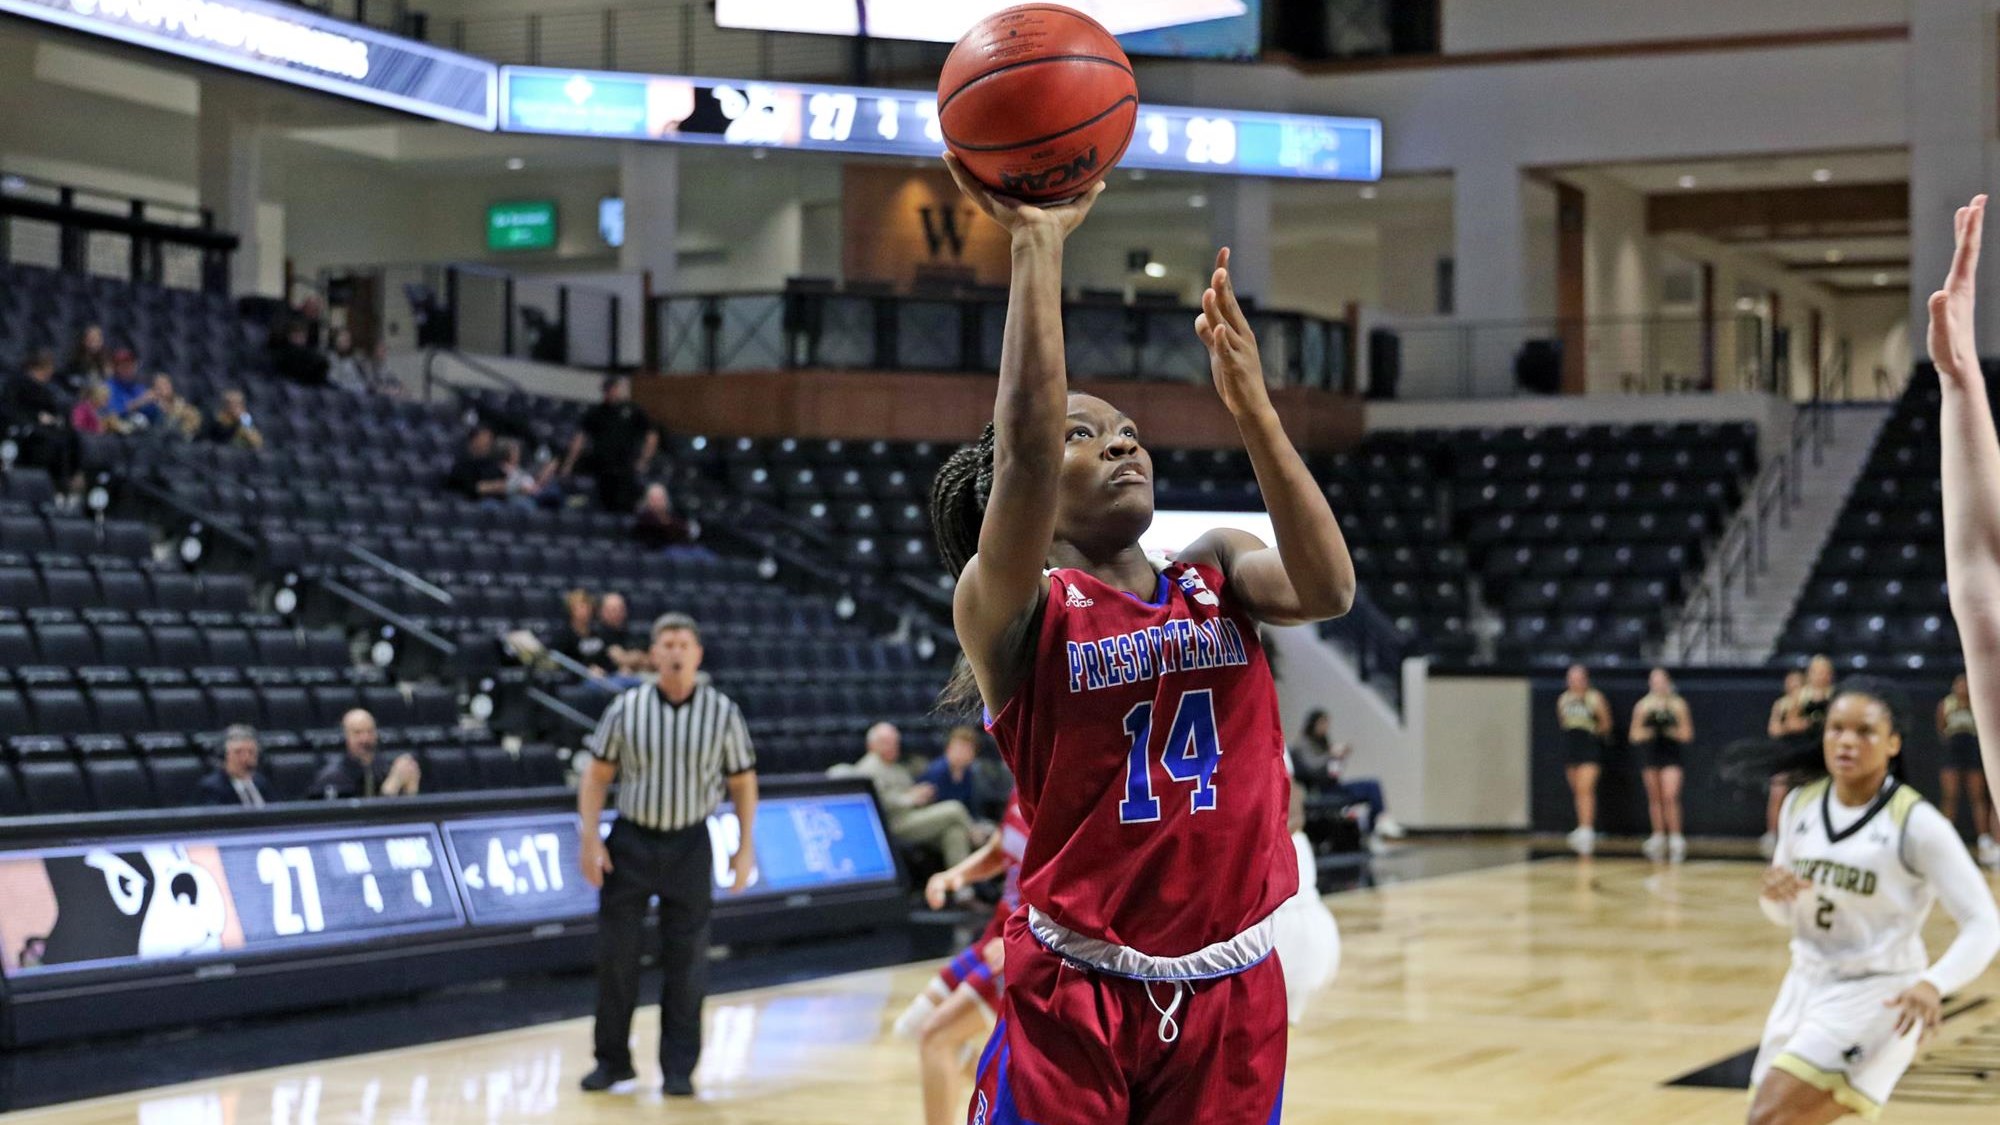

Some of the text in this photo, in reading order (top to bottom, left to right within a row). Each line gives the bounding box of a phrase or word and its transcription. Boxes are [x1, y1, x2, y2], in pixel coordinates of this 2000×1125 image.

[809, 92, 857, 141] 27
[1000, 145, 1098, 193] NCAA
[919, 206, 975, 256] W
[1065, 596, 1094, 608] adas
[1067, 616, 1248, 693] PRESBYTERIAN
[1119, 688, 1222, 824] 14
[487, 833, 564, 896] 4:17
[256, 846, 325, 936] 27
[1815, 896, 1835, 930] 2
